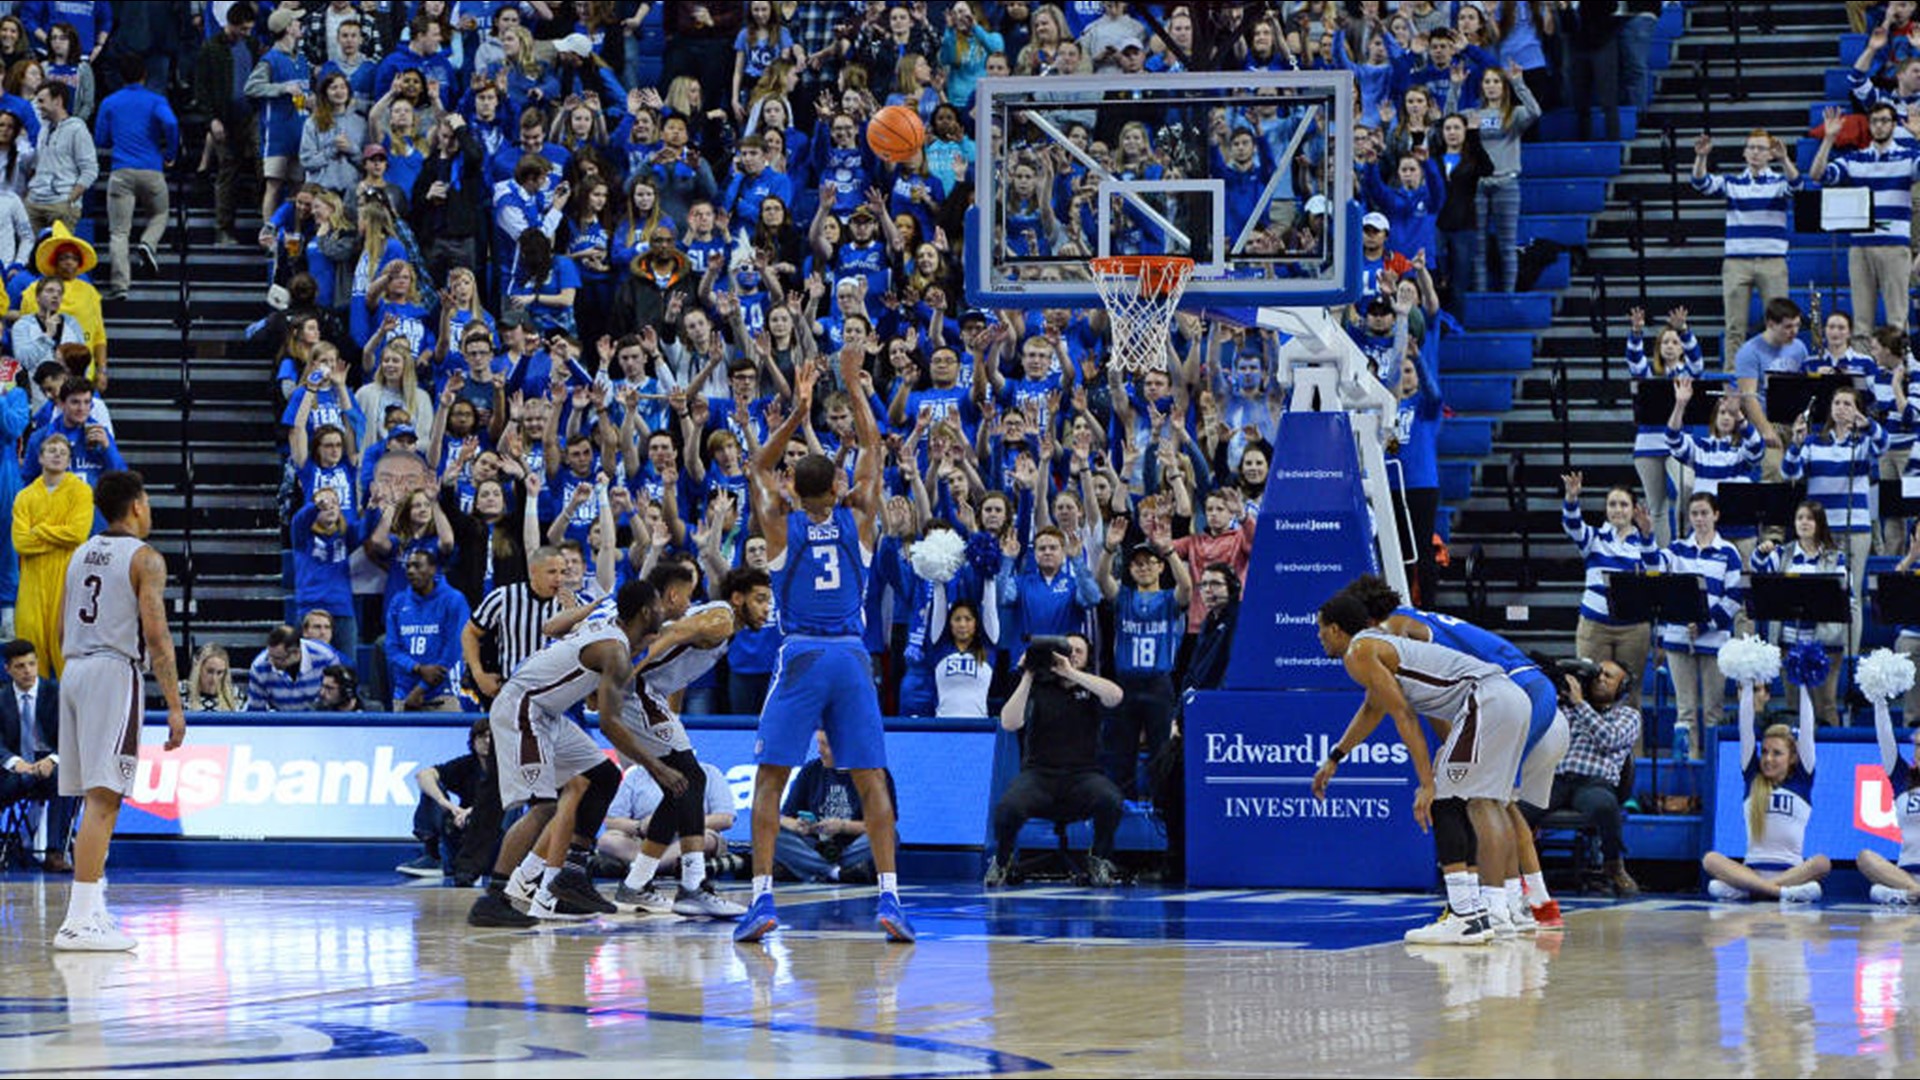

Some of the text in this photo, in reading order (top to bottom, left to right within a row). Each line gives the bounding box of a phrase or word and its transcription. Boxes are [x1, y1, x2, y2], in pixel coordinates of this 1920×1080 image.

[752, 50, 771, 65] KC
[1276, 469, 1343, 480] @edwardjones
[807, 525, 839, 541] BESS
[812, 545, 841, 591] 3
[1275, 562, 1342, 573] @edwardjones
[79, 574, 102, 624] 3
[410, 636, 426, 655] 18
[1133, 637, 1156, 667] 18
[946, 658, 977, 679] SLU
[1226, 797, 1391, 819] INVESTMENTS
[1768, 795, 1793, 816] LU
